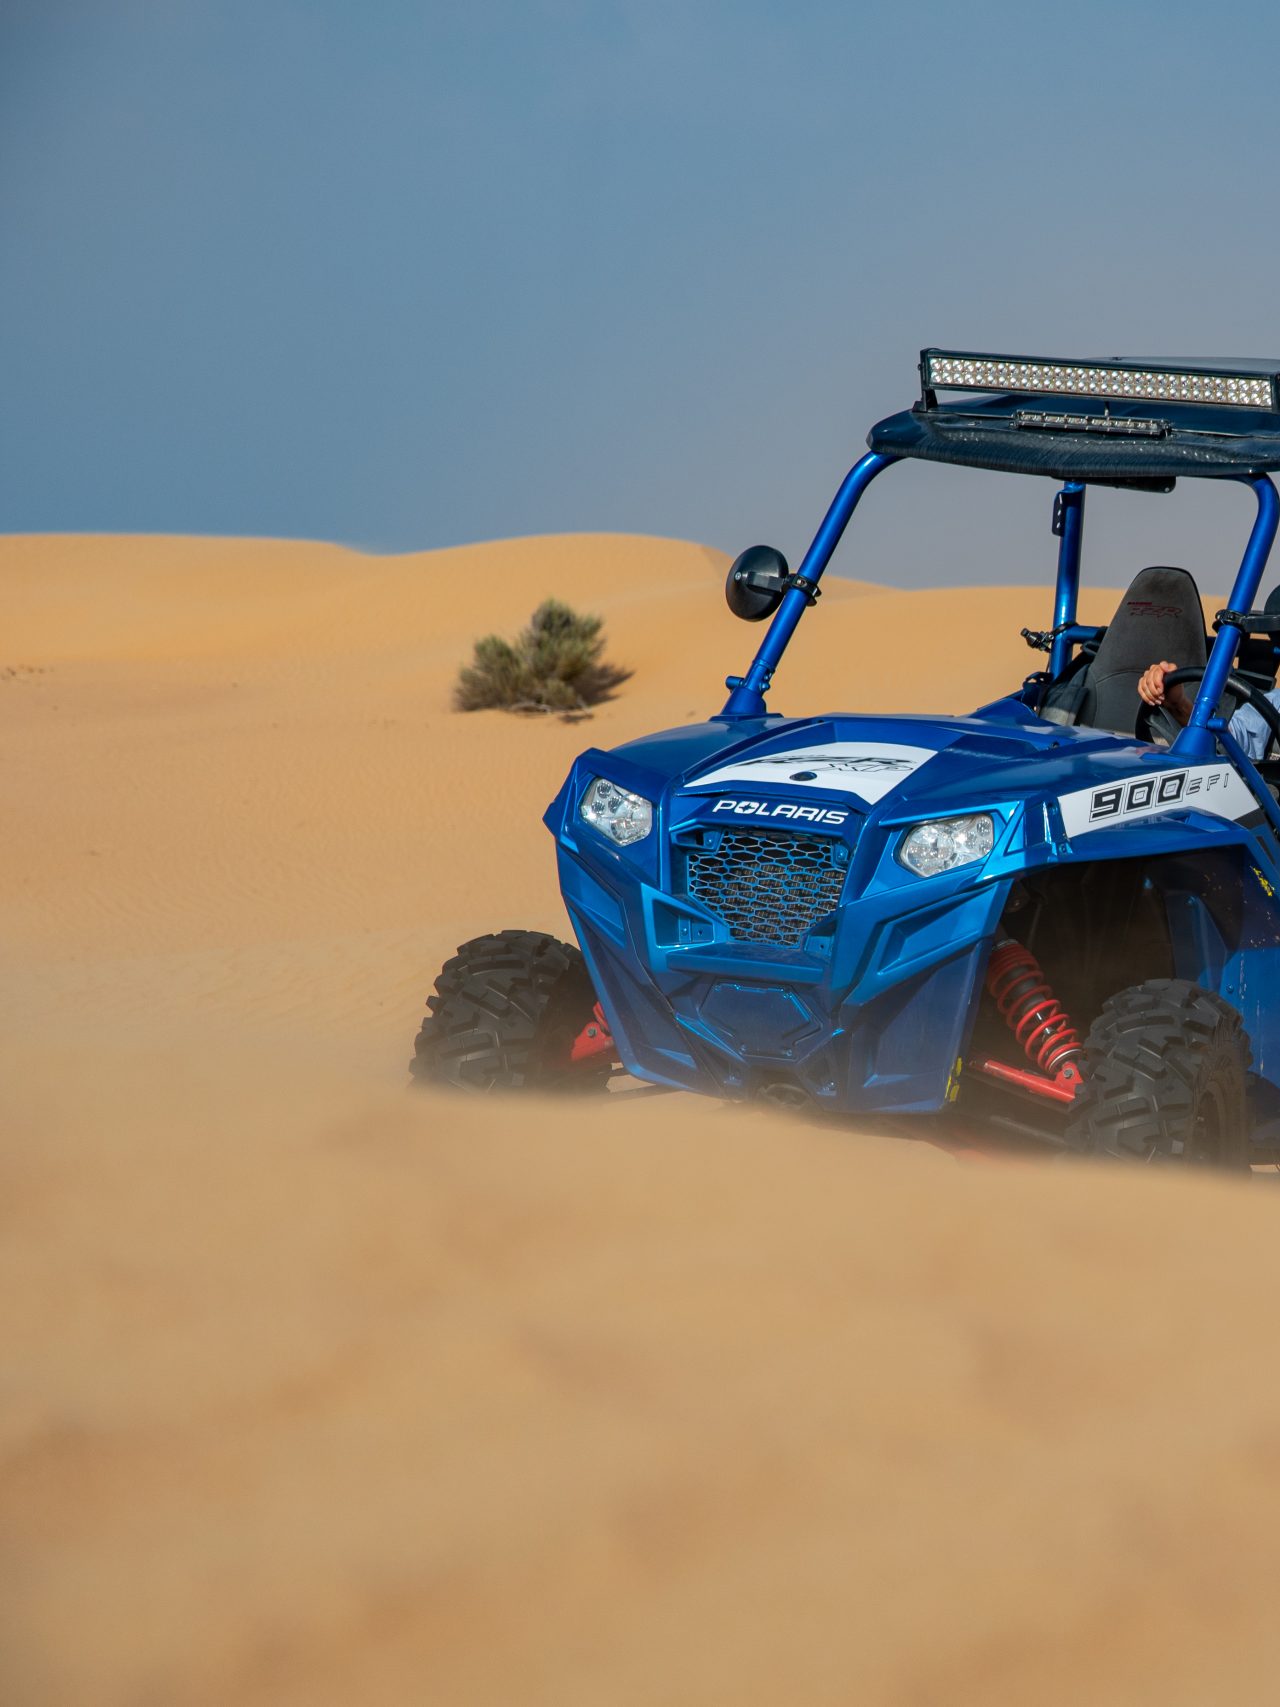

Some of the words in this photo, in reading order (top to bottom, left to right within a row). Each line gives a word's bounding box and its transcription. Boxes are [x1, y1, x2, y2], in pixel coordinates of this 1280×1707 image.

[712, 800, 849, 825] POLARIS
[1089, 770, 1189, 822] 900
[1186, 773, 1229, 795] EFI
